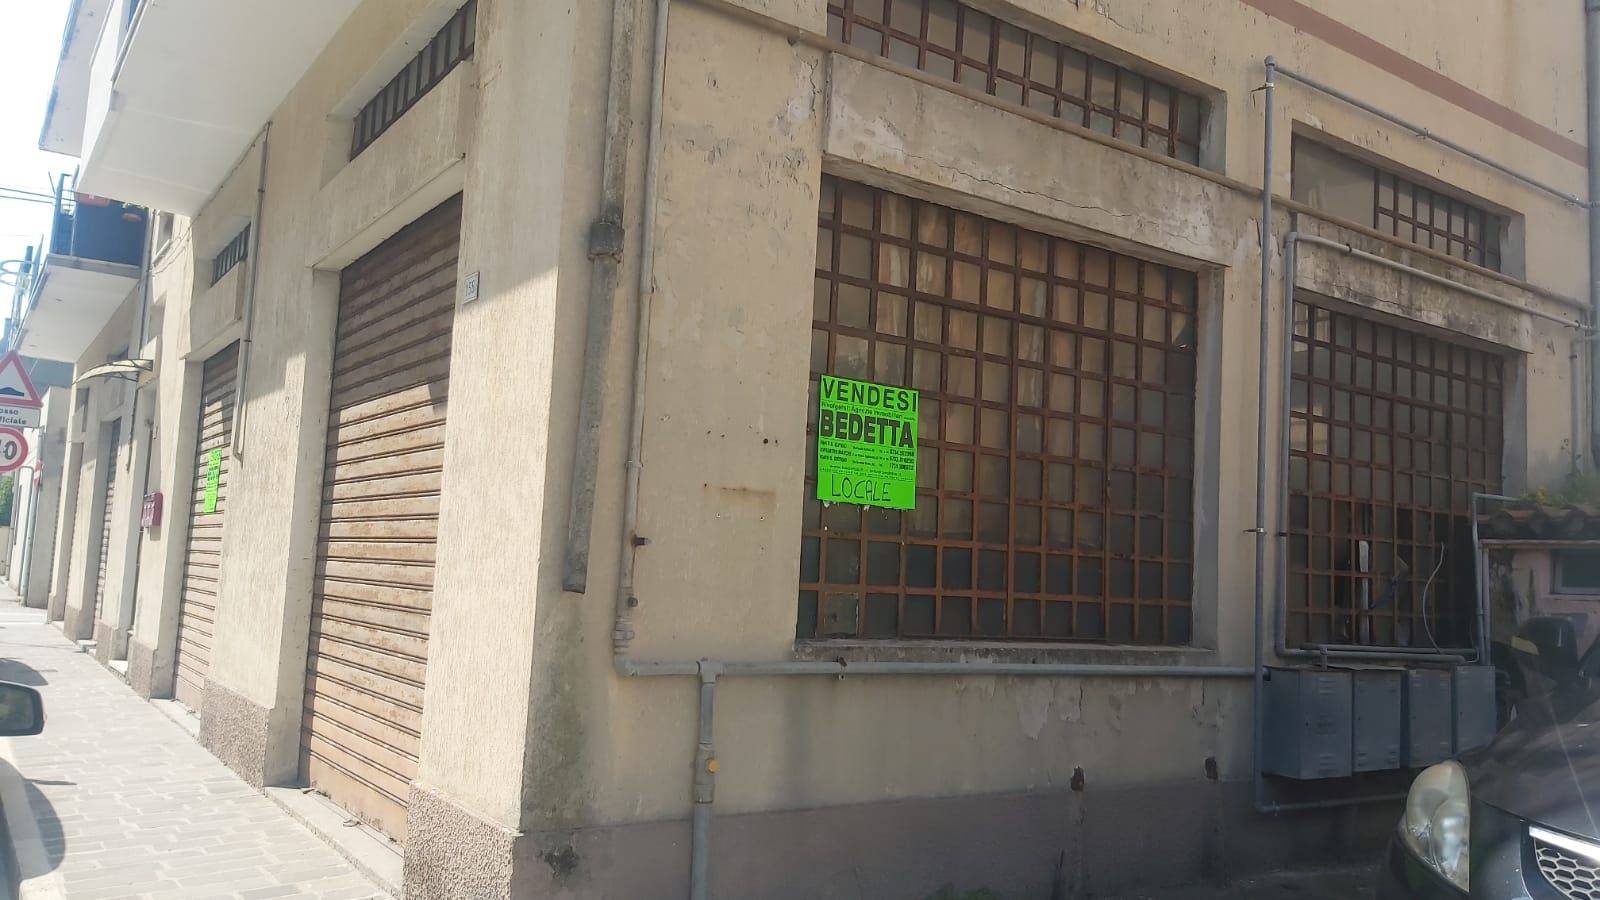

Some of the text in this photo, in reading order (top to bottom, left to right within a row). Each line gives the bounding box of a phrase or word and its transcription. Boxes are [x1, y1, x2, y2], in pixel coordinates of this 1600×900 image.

[822, 377, 917, 412] VENDESI
[820, 408, 914, 449] BEDETTA
[0, 440, 18, 461] 0
[831, 473, 892, 502] LOCALE
